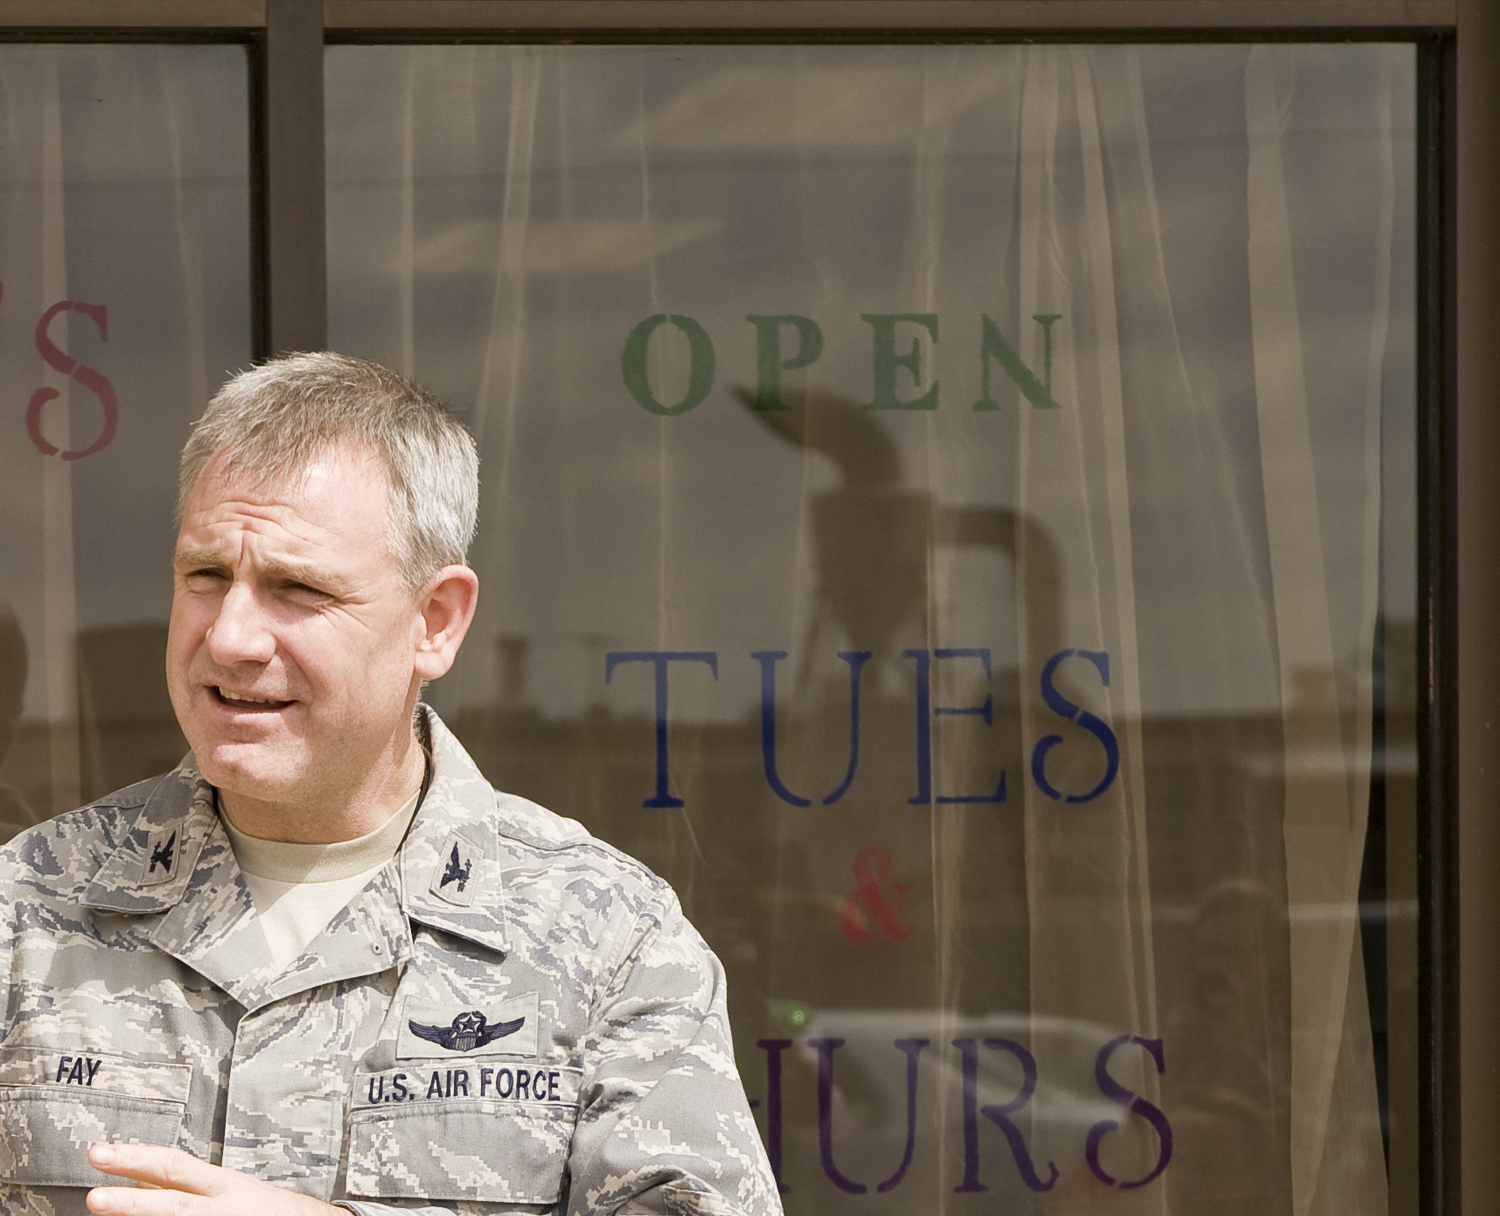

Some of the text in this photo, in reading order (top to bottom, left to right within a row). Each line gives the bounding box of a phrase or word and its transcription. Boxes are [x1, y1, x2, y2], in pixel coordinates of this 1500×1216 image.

[621, 313, 1062, 416] OPEN
[605, 648, 1119, 808] TUES
[840, 846, 913, 946] &
[55, 1056, 102, 1086] FAY
[368, 1068, 561, 1104] U.S. AIR FORCE
[748, 1034, 1173, 1194] URS
